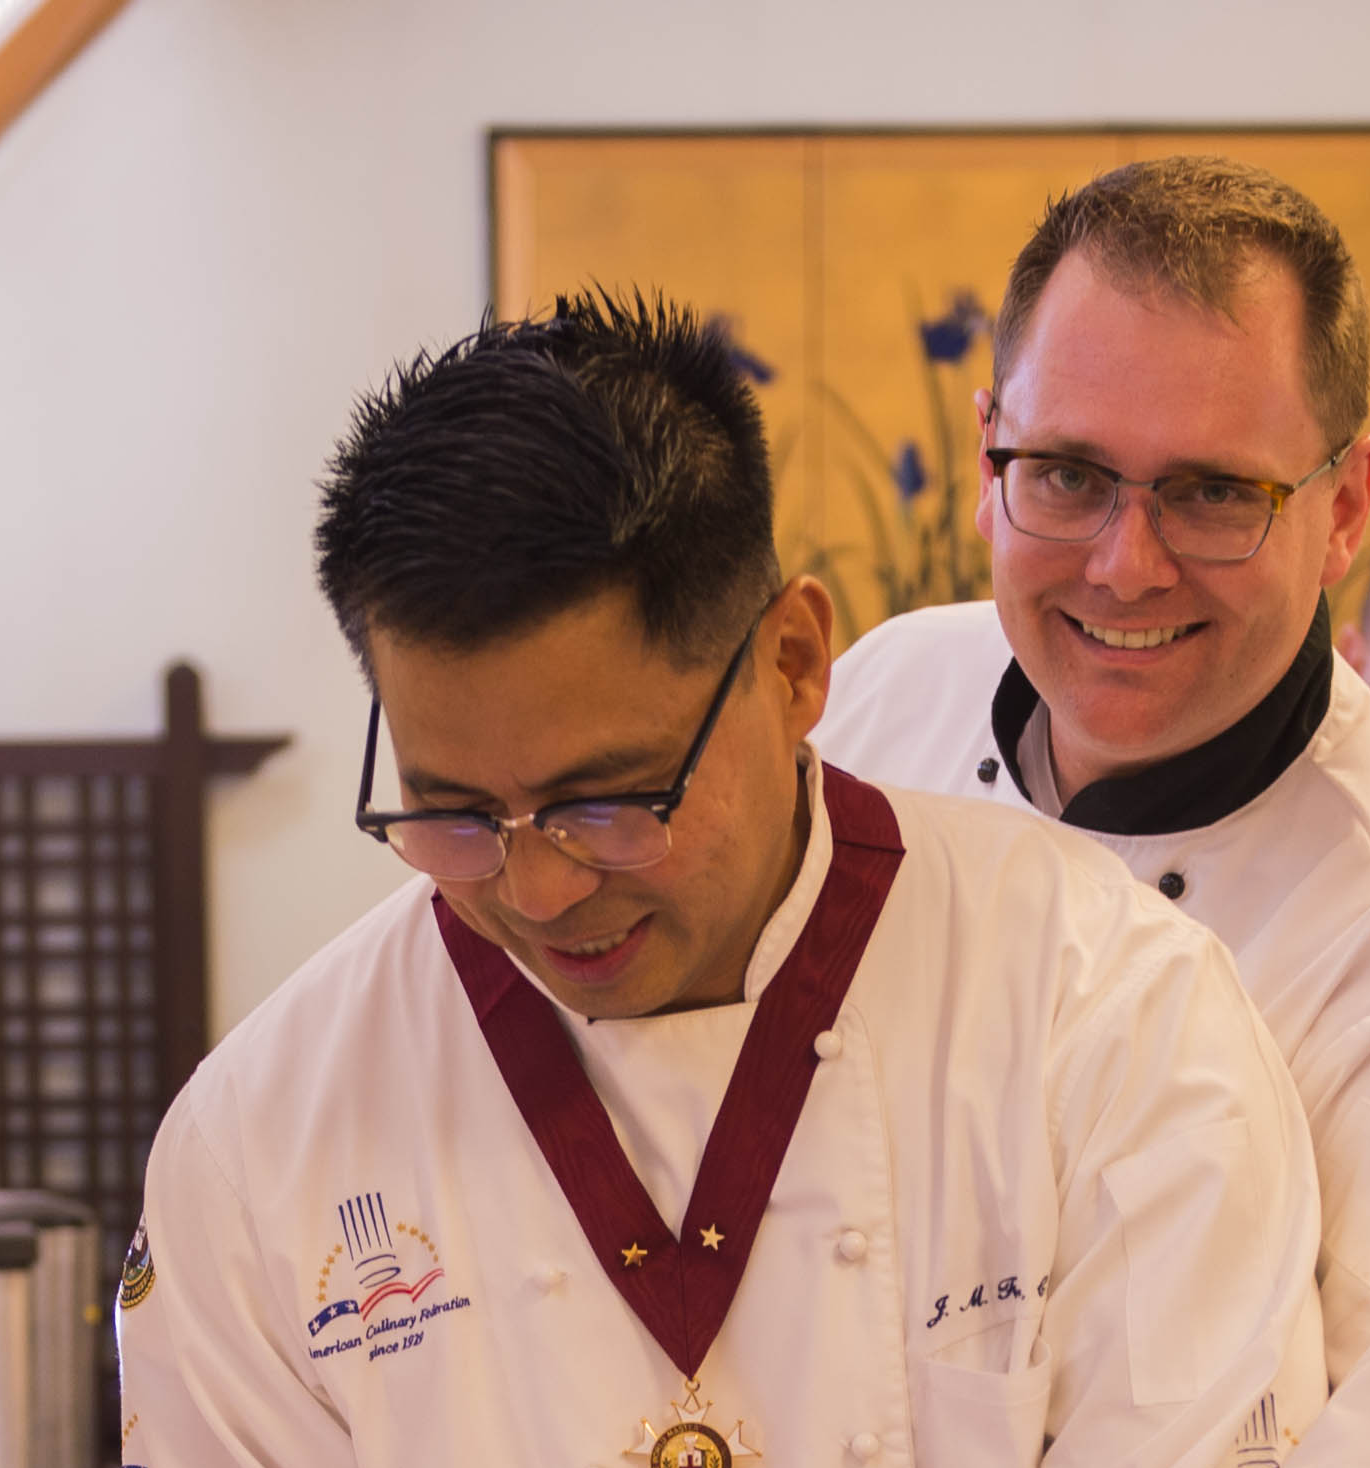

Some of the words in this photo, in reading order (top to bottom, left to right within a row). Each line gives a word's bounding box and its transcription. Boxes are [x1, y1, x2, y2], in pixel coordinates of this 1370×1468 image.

[926, 1294, 949, 1328] J.
[958, 1283, 989, 1312] M.
[365, 1315, 417, 1340] Culinary
